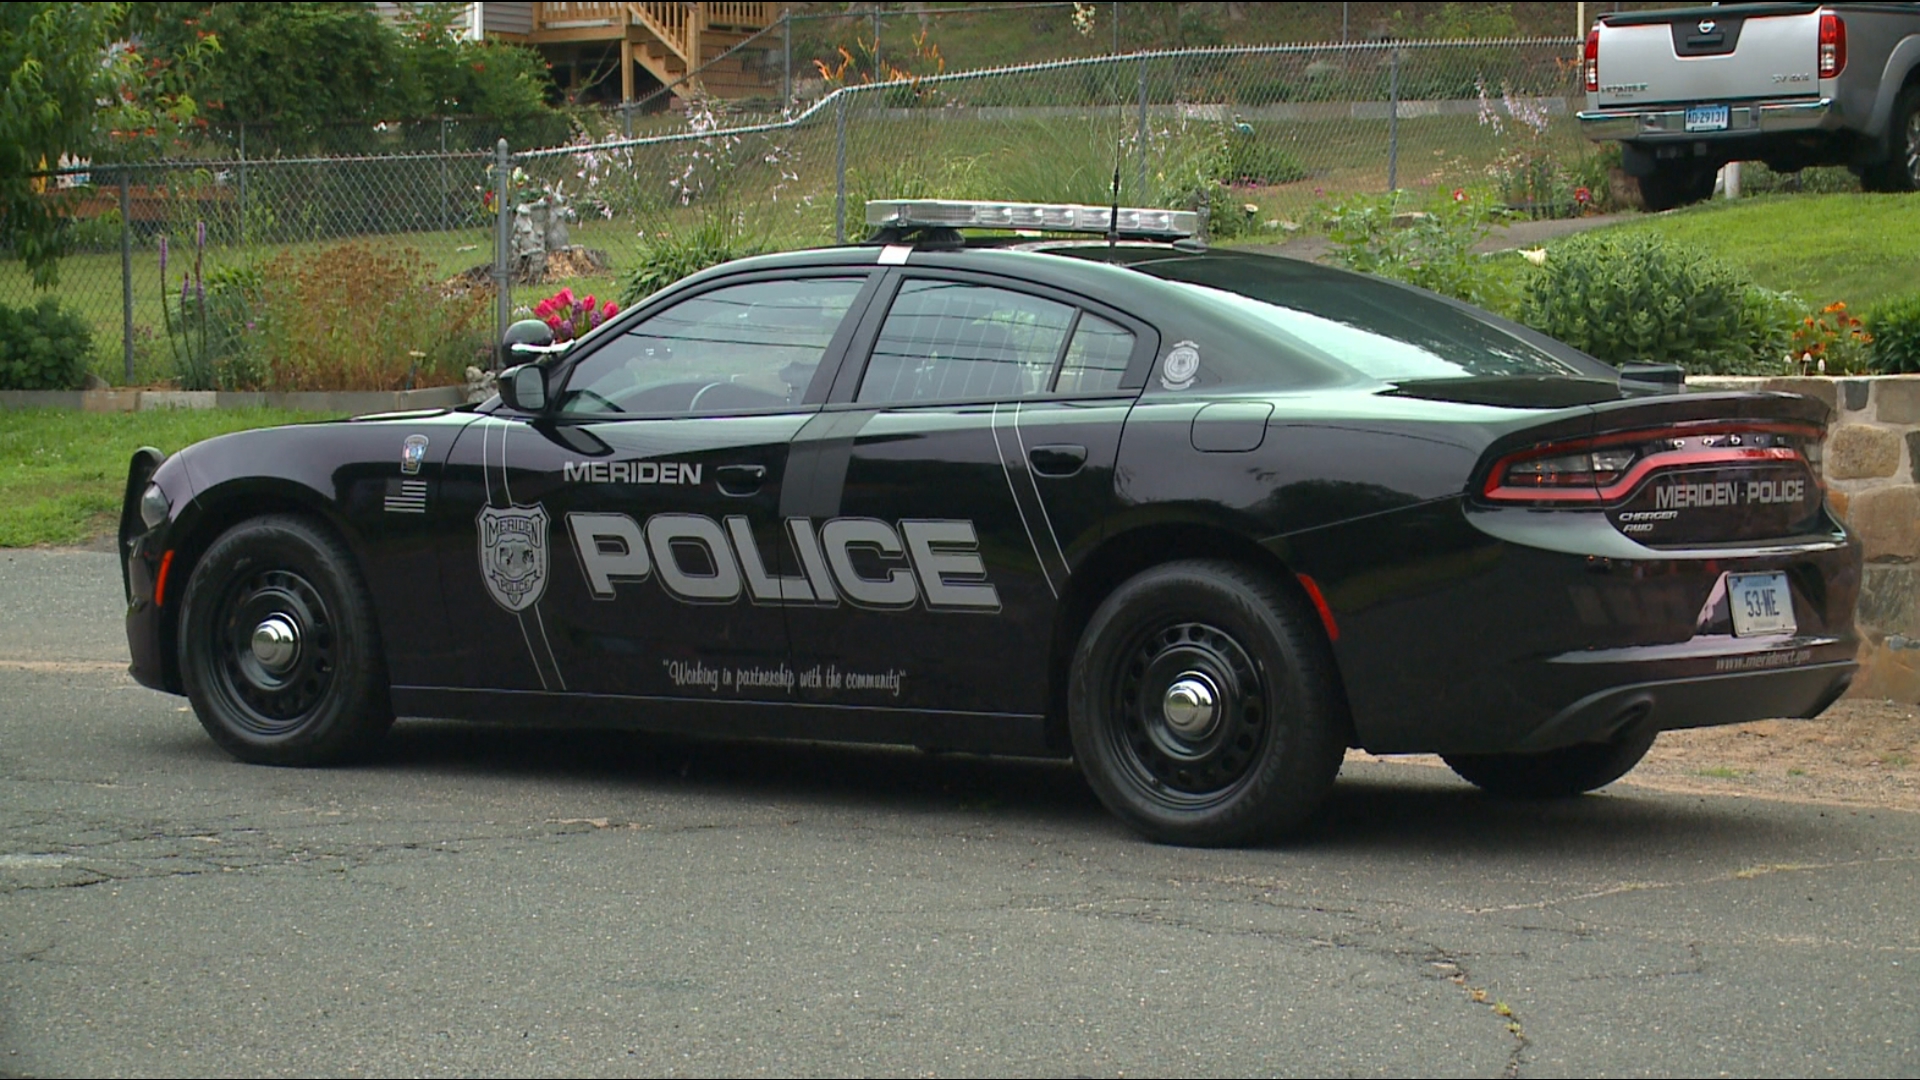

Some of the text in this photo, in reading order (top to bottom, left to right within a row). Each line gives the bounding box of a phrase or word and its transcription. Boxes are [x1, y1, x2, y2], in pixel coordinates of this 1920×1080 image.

[563, 461, 703, 486] MERIDEN
[1655, 479, 1805, 510] MERIDEN POLICE
[1618, 510, 1679, 522] CHARGER
[1622, 523, 1654, 533] AWD
[488, 517, 539, 544] MERIDEN
[564, 510, 1003, 614] POLICE
[500, 579, 530, 592] POLICE
[1715, 650, 1811, 670] www.meridenct.gov
[722, 667, 732, 685] in
[736, 662, 795, 694] partnership
[799, 664, 822, 688] with
[825, 664, 842, 689] the
